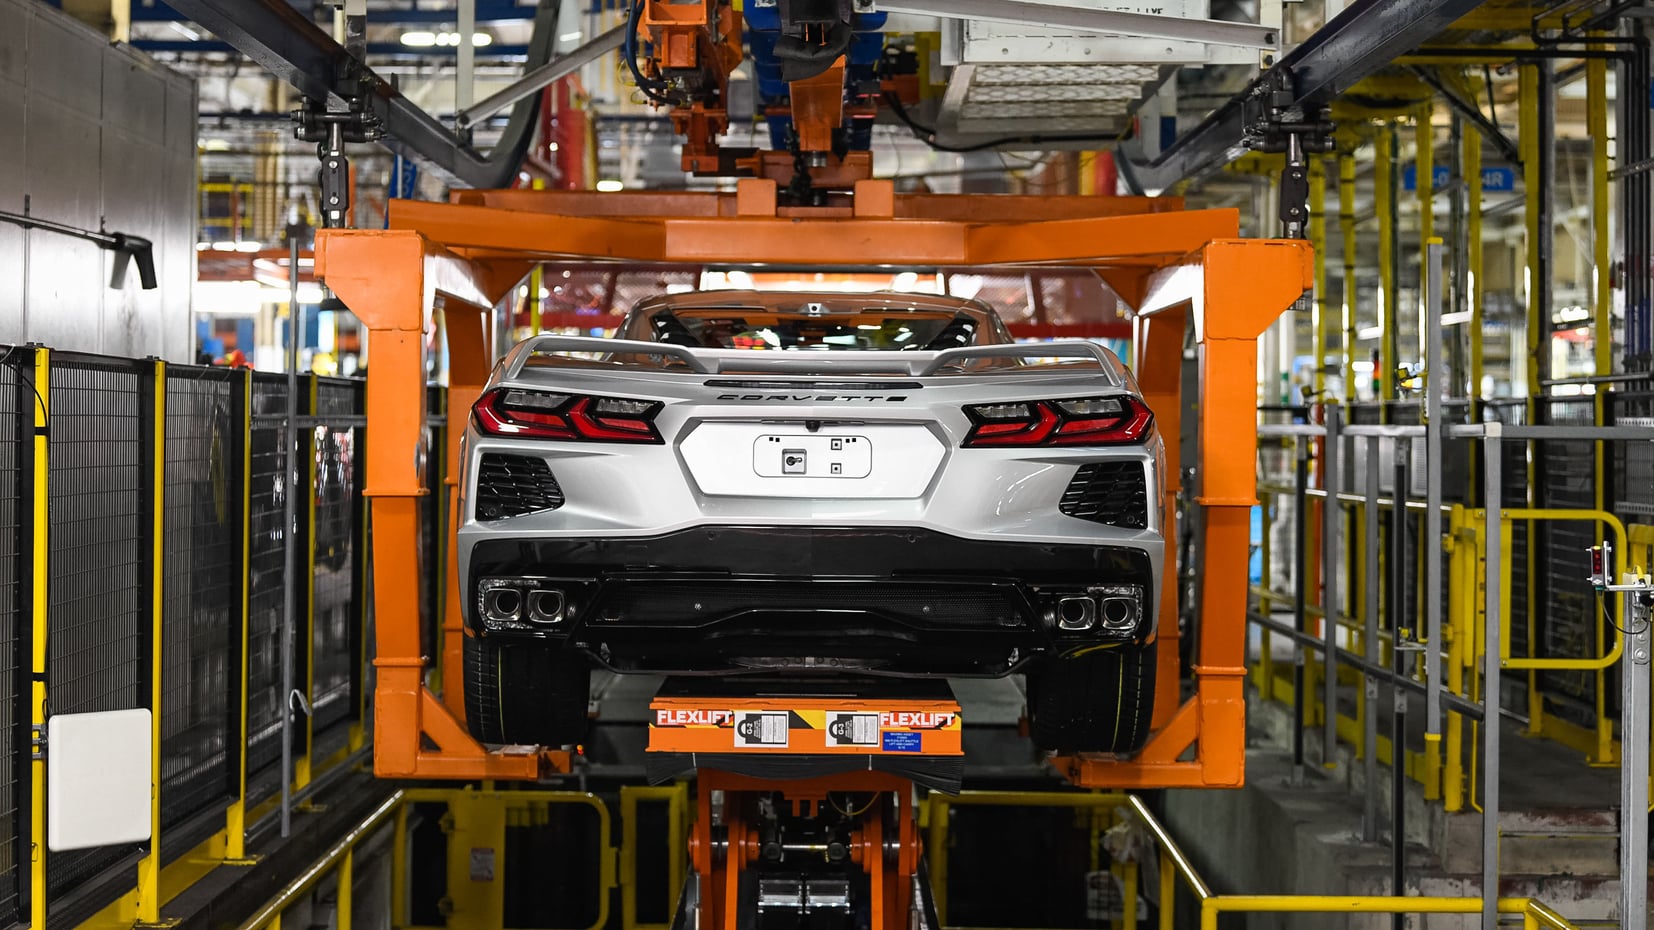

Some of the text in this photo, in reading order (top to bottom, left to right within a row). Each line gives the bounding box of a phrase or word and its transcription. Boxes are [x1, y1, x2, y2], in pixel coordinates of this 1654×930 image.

[716, 394, 908, 402] CORVETTE
[657, 710, 733, 724] FLEXLIFT
[880, 712, 955, 726] FLEXLIFT
